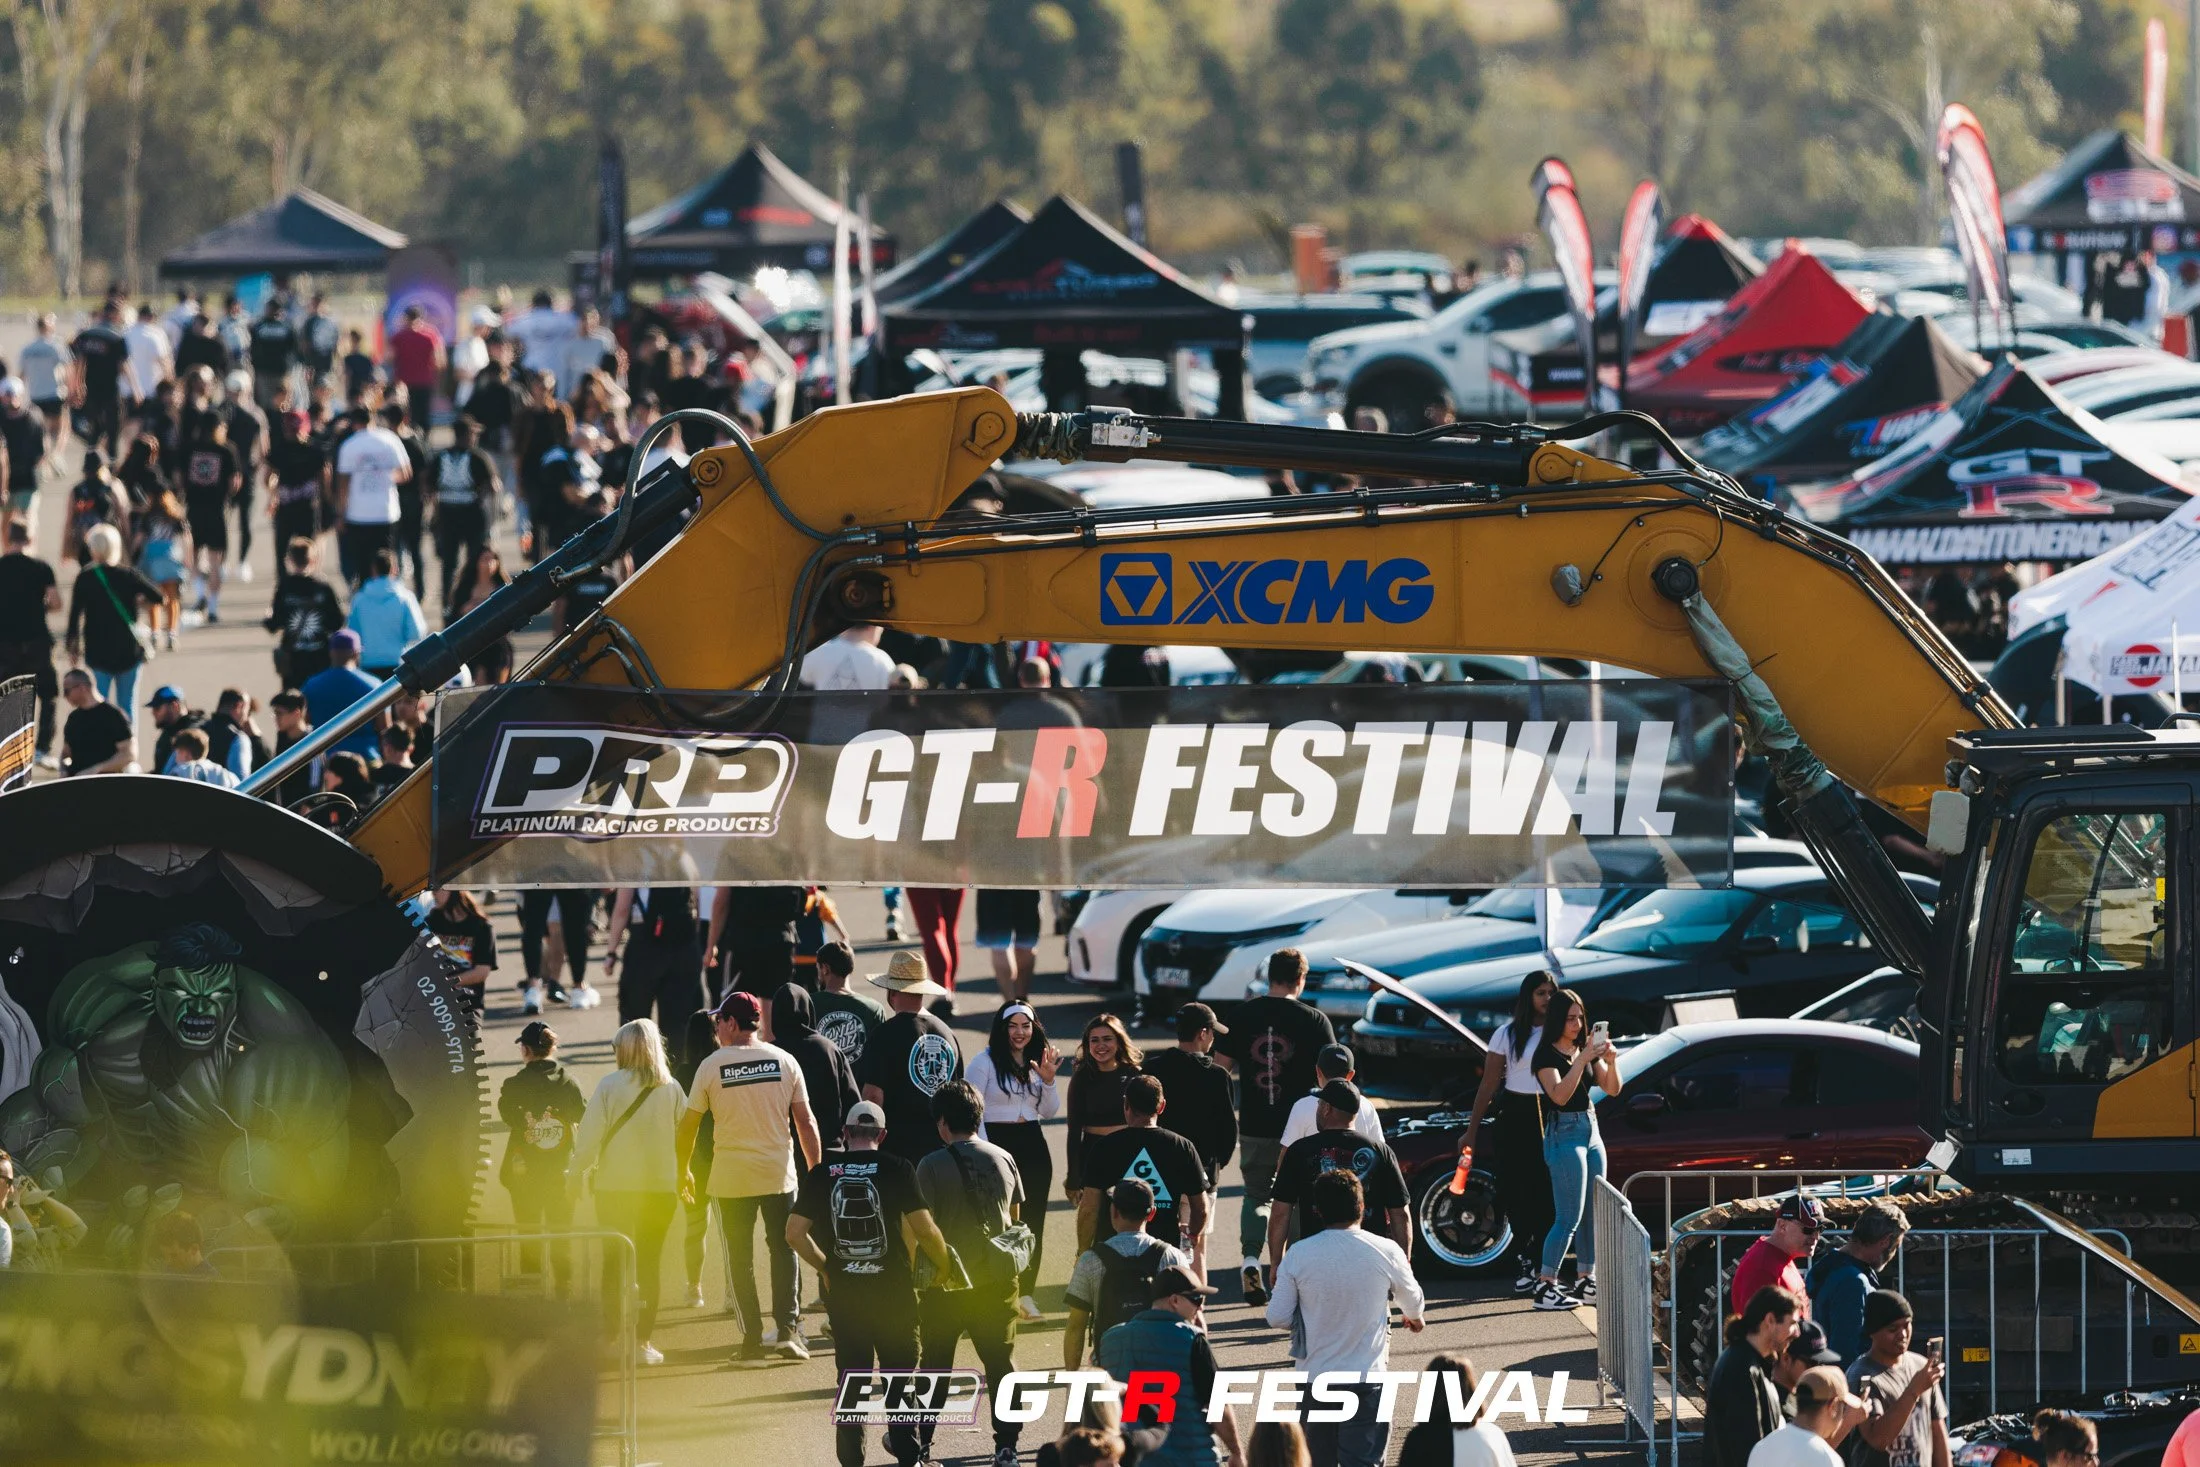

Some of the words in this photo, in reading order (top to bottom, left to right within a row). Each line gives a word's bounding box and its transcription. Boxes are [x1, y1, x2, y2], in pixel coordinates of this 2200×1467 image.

[1956, 473, 2115, 518] R
[1173, 557, 1435, 625] XCMG
[488, 733, 784, 810] PRP
[825, 727, 1108, 842] GT-R
[1128, 719, 1677, 837] FESTIVAL
[478, 815, 576, 833] PLATINUM
[582, 818, 658, 835] RACING
[664, 816, 771, 833] PRODUCTS
[417, 976, 436, 997] 02
[429, 996, 465, 1074] 9099-9774
[180, 1320, 550, 1413] SYDNY
